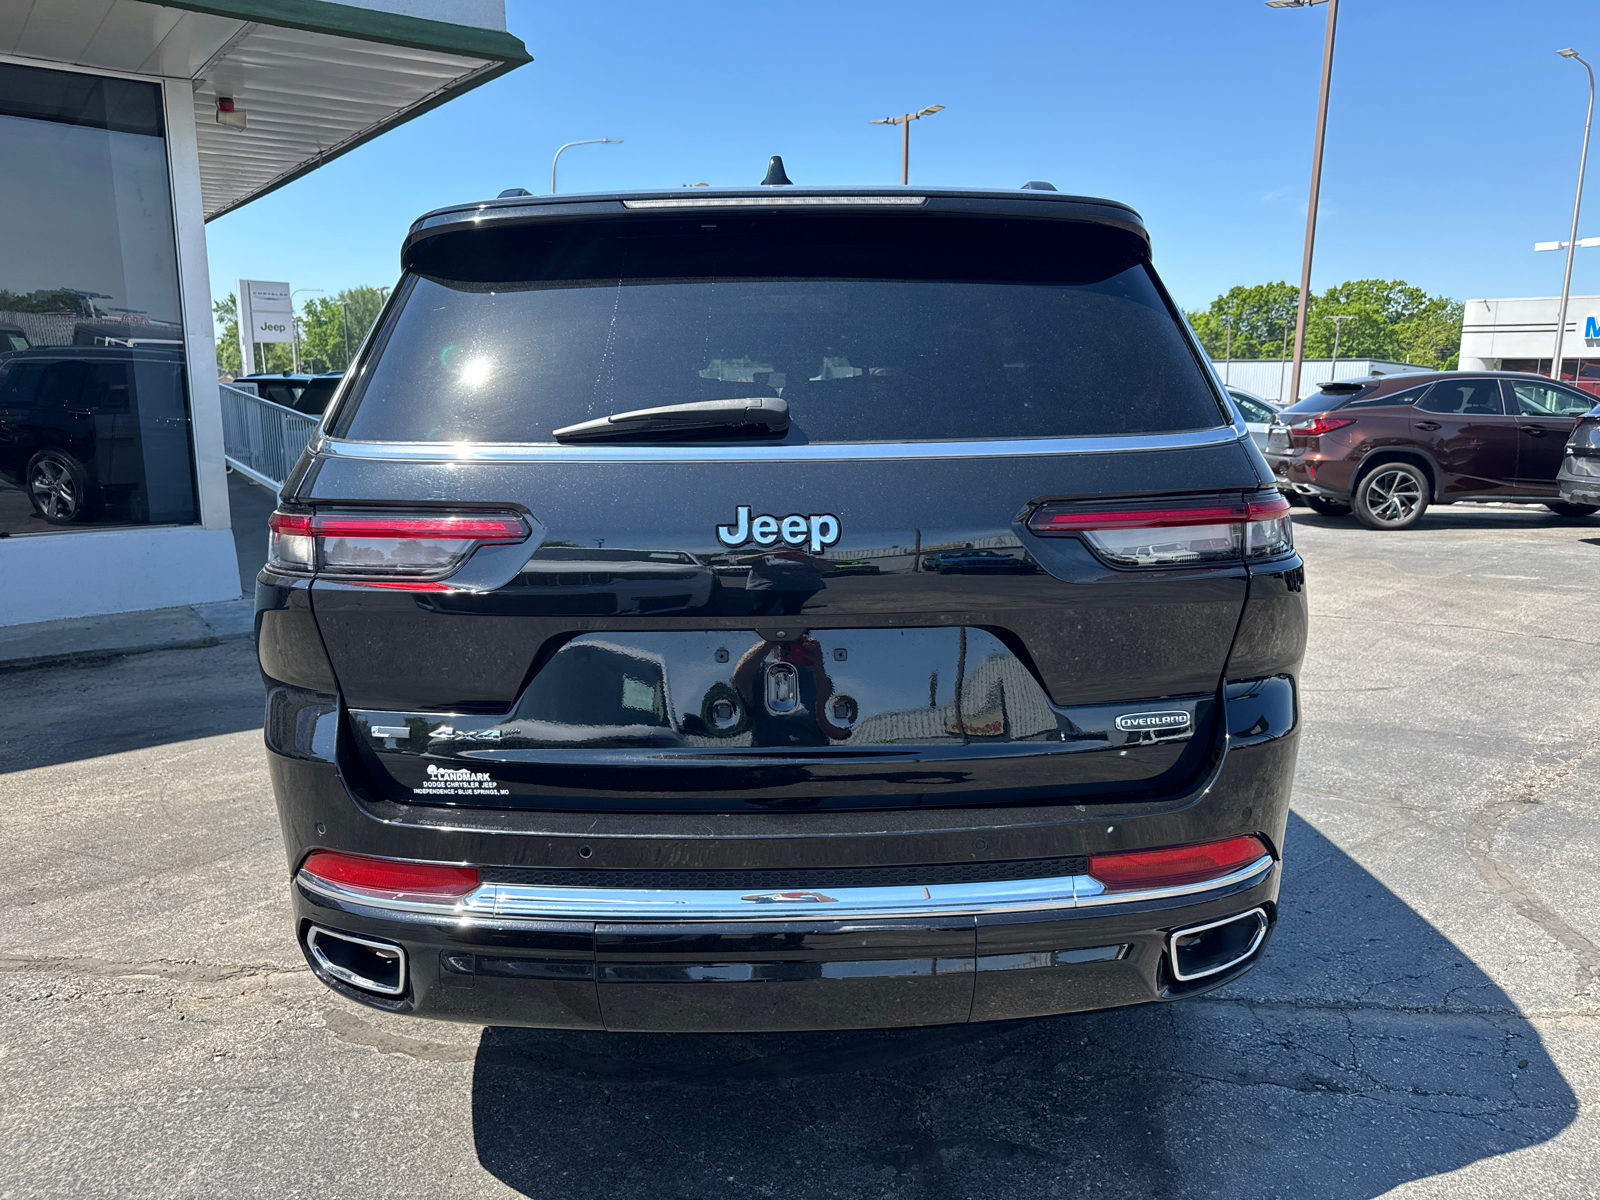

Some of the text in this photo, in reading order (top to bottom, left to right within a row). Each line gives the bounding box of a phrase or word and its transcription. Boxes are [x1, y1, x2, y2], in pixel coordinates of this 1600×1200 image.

[260, 321, 286, 333] Jeep
[717, 505, 841, 553] Jeep
[1121, 714, 1187, 728] OVERLAND
[428, 725, 503, 741] 4x4
[437, 772, 491, 781] LANDMARK
